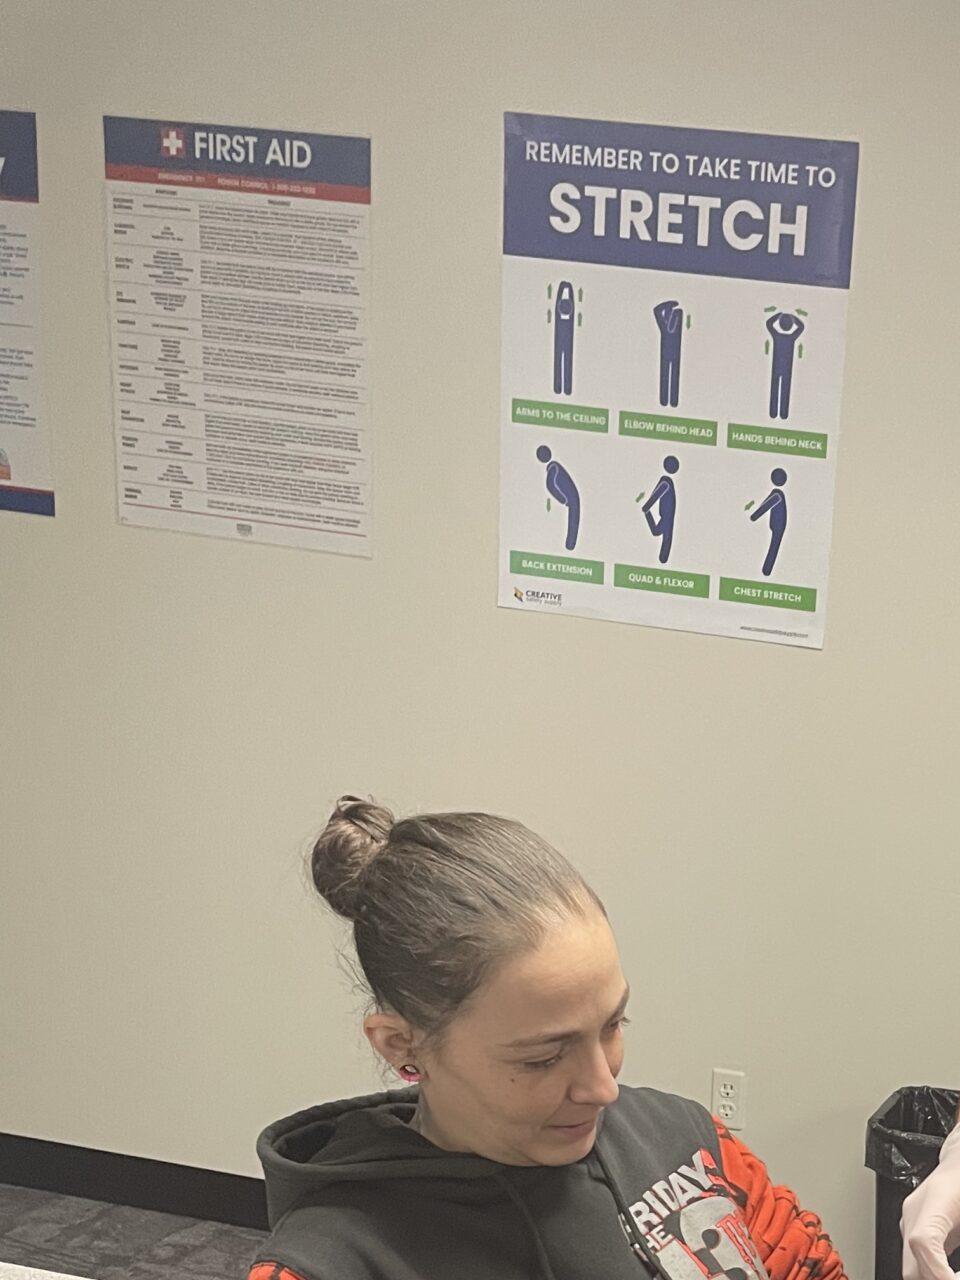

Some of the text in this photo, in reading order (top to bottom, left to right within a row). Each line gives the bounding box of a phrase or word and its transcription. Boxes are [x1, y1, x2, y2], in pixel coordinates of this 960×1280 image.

[194, 131, 312, 169] FIRST AID
[525, 140, 836, 188] REMEMBER TO TAKE TIME TO
[549, 182, 808, 256] STRETCH
[515, 406, 606, 426] ARMS TO THE CEILING
[624, 419, 713, 438] ELBOW BEHIND HEAD
[732, 432, 823, 450] HANDS BEHIND NECK
[521, 559, 593, 577] BACK EXTENSION
[628, 573, 695, 589] QUAD & FLEXOR
[525, 590, 562, 601] CREATIVE
[733, 586, 801, 602] CHEST STRETCH
[627, 1149, 714, 1236] RIDAY
[645, 1223, 674, 1253] HE
